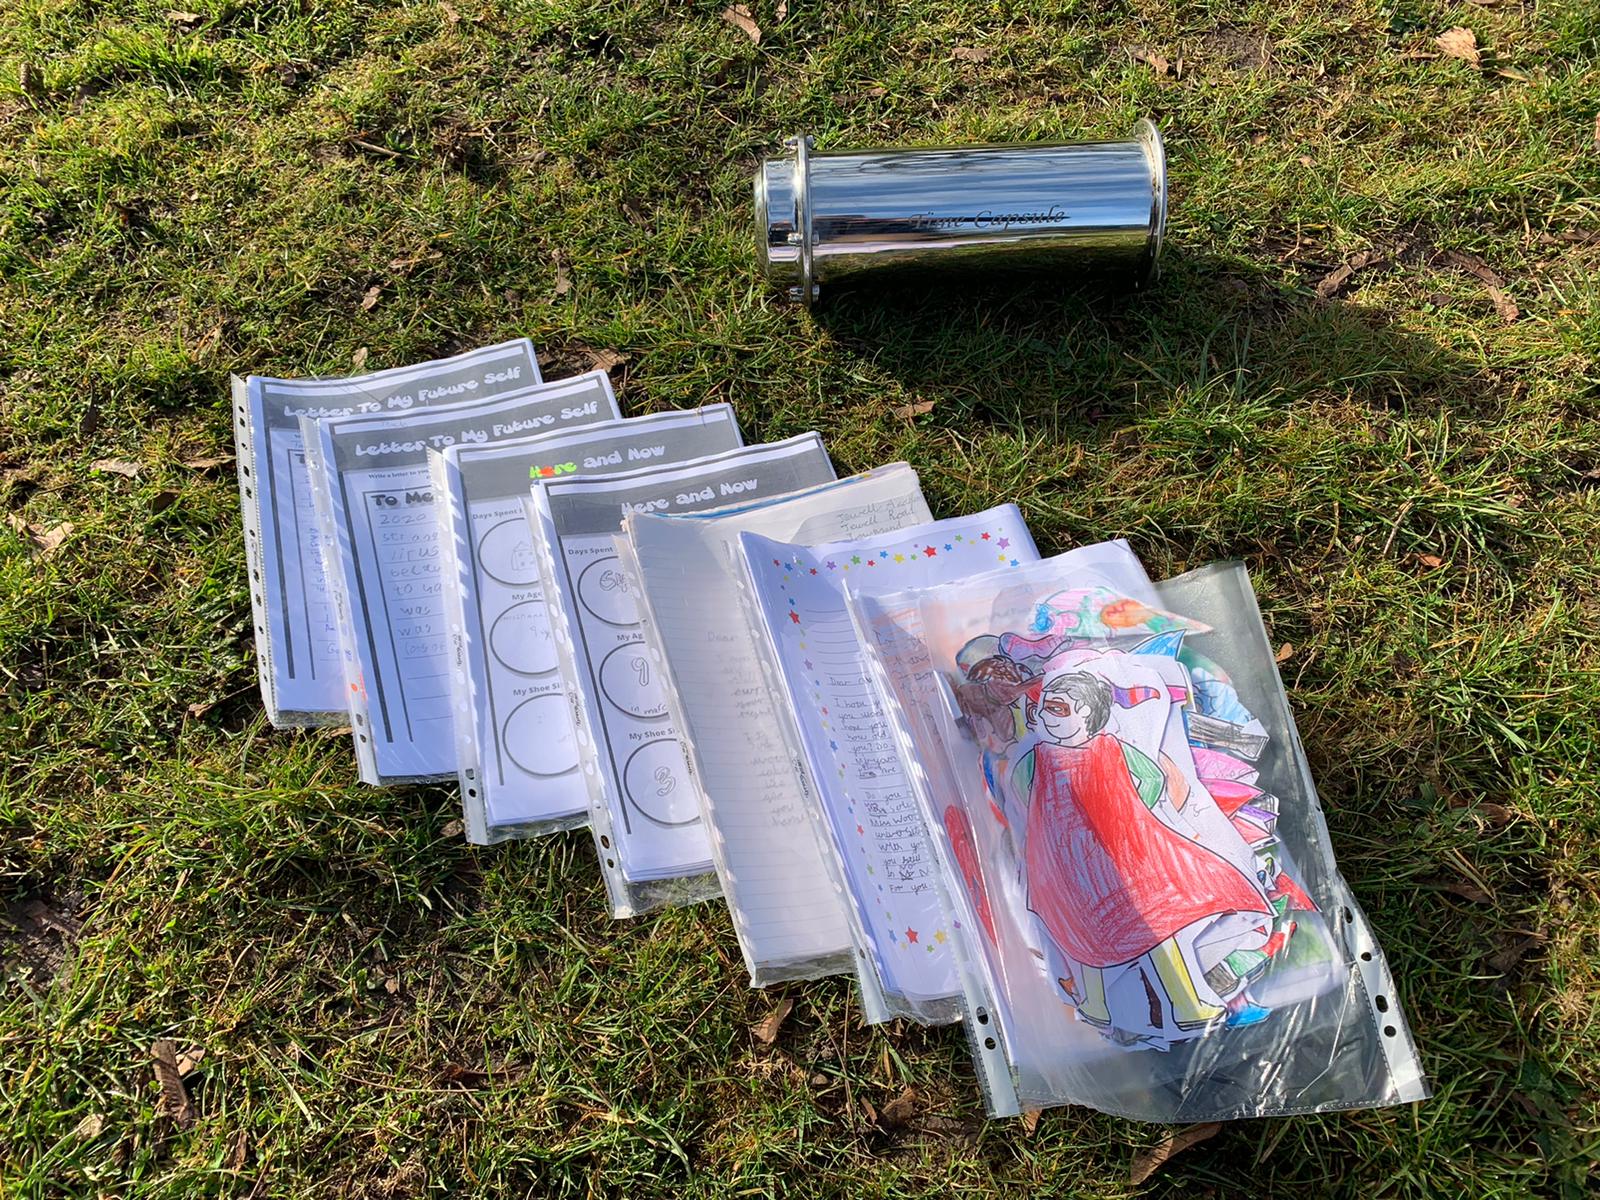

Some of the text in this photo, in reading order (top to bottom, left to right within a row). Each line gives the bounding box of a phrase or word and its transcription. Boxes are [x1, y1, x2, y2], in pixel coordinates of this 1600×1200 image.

[908, 204, 1065, 230] Time Capsule
[284, 366, 521, 419] Letter To My Future Self
[355, 401, 599, 457] Letter To My Future Self
[528, 443, 665, 479] Here and Now
[371, 494, 398, 506] To
[621, 477, 758, 516] Here and Now
[568, 546, 614, 556] Days Spent
[616, 633, 630, 642] My
[513, 689, 527, 697] My
[529, 685, 551, 694] Shoe
[629, 732, 642, 741] My
[644, 729, 666, 739] Shoe
